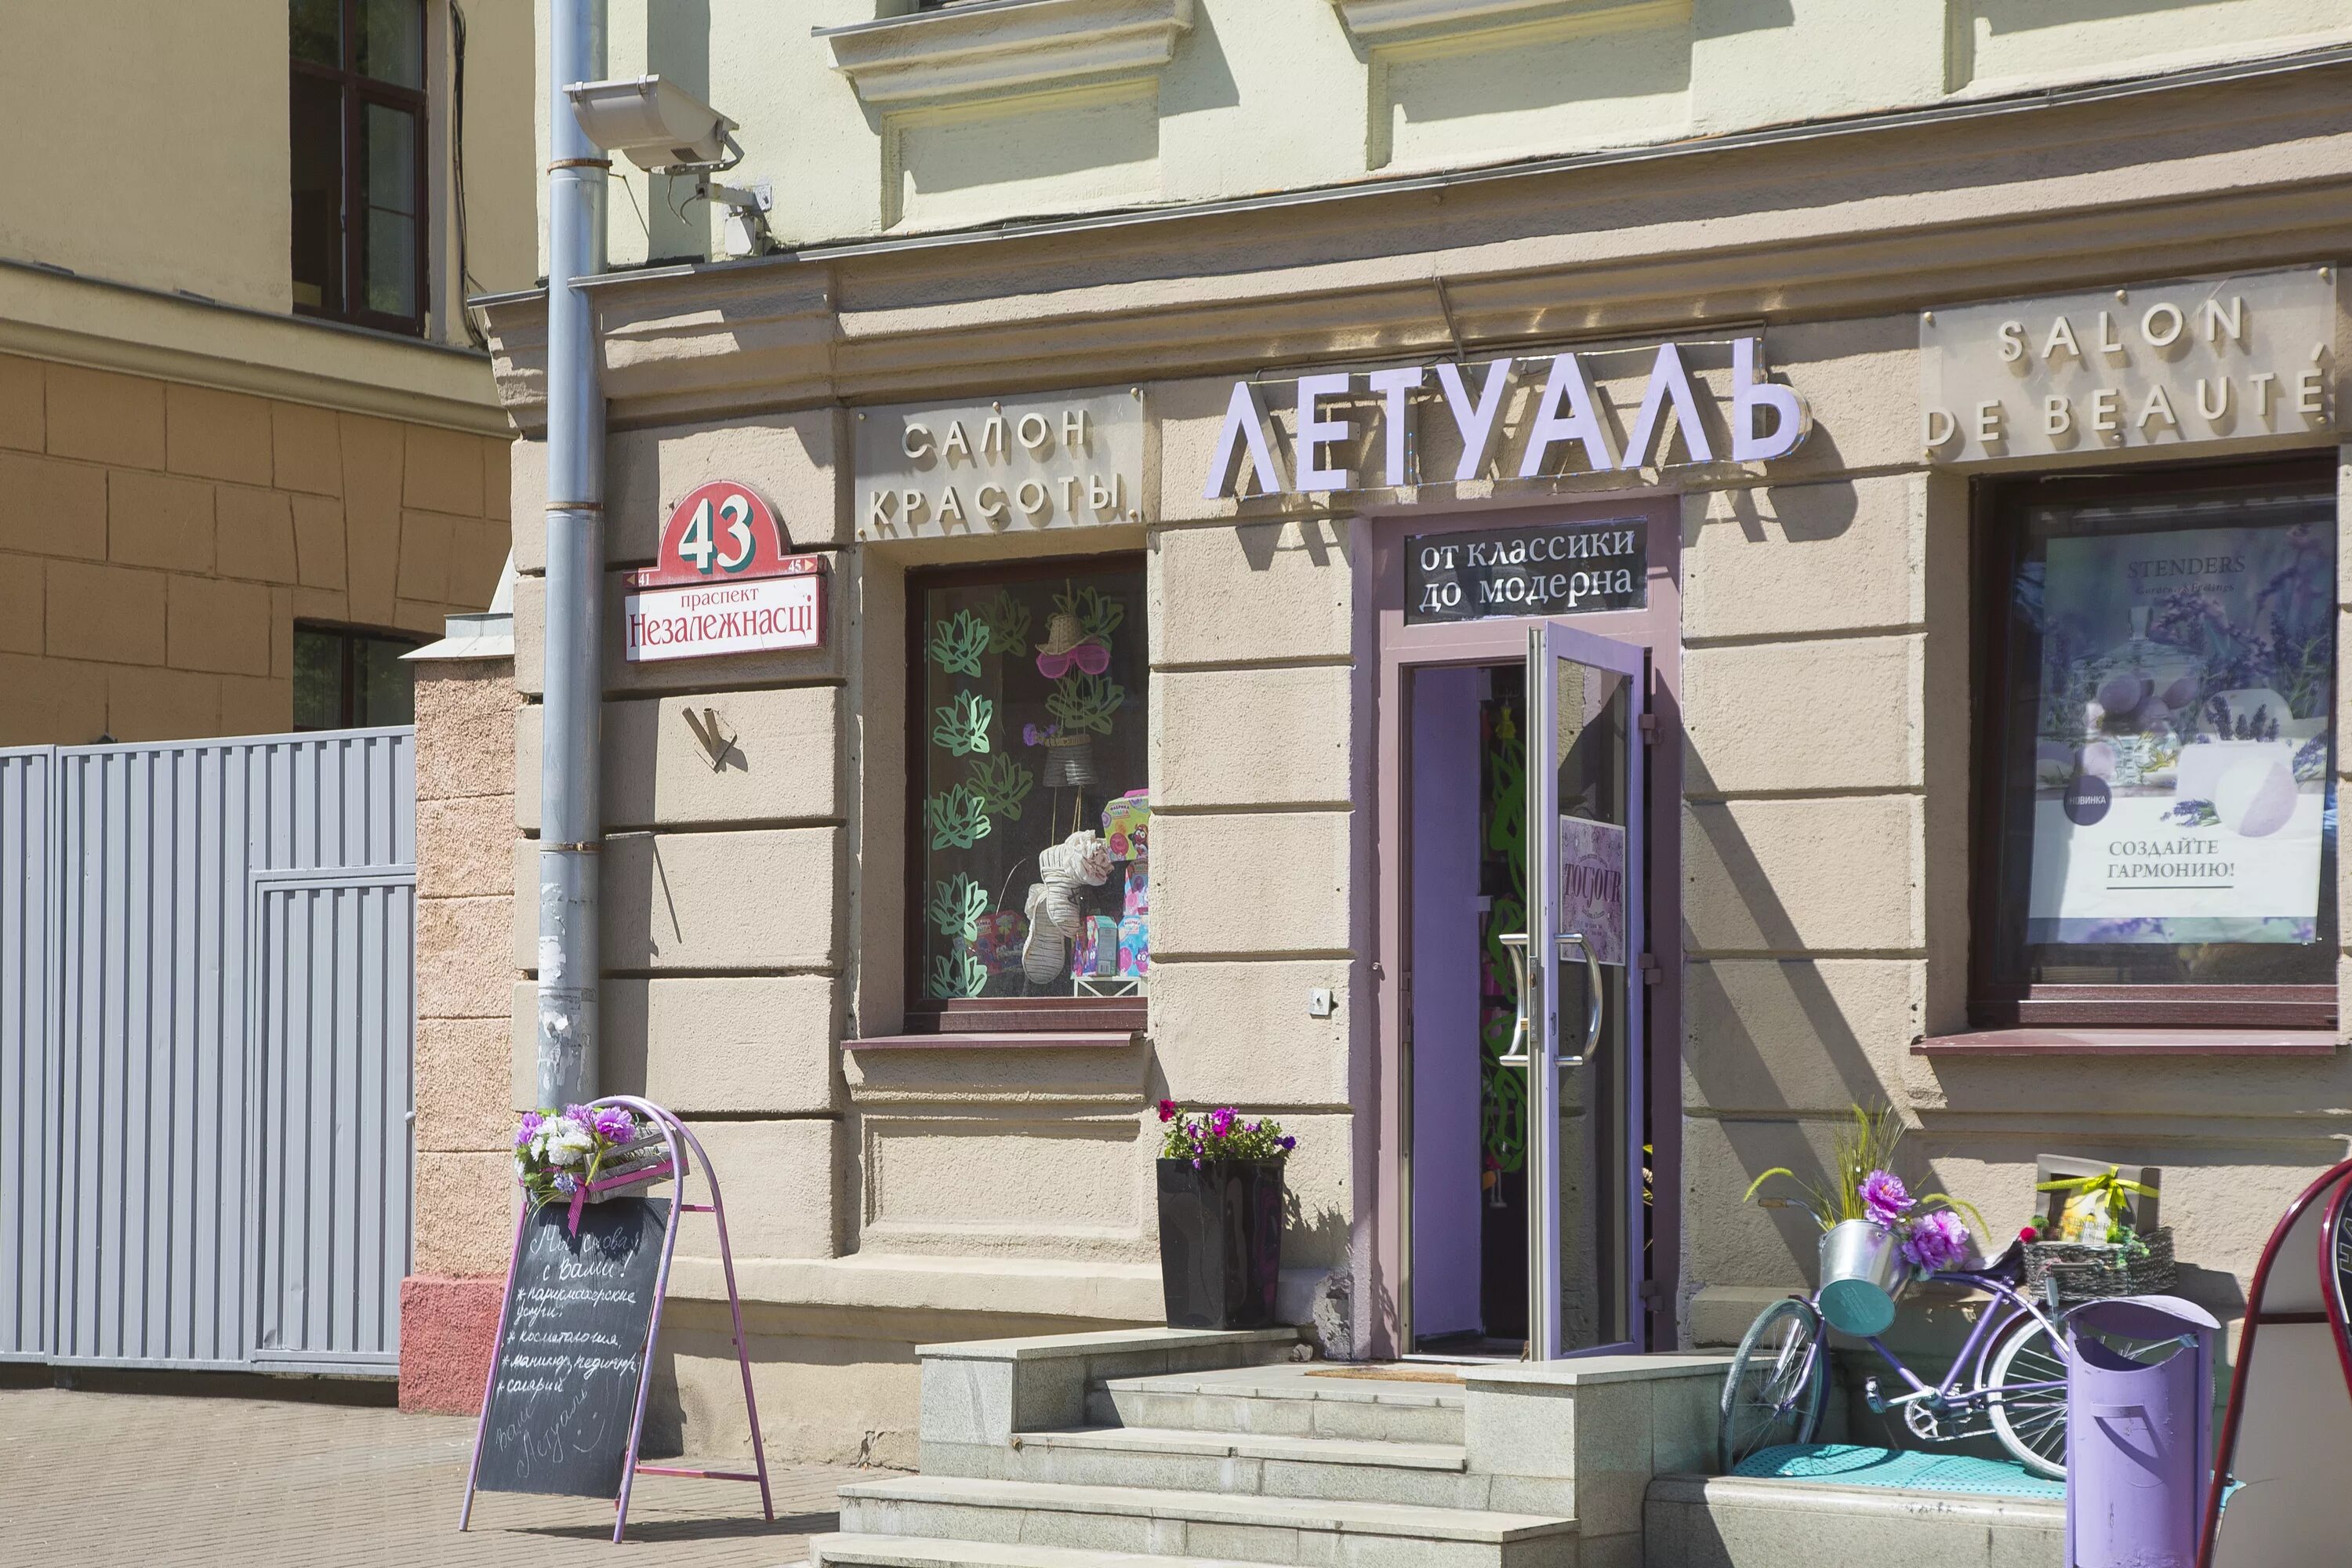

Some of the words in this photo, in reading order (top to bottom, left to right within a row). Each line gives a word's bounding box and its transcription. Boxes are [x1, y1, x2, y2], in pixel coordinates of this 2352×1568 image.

[1998, 296, 2241, 362] SALON
[1925, 399, 2002, 447] DE
[2044, 343, 2326, 436] BEAUTÉ
[902, 409, 1085, 459] САЛОН
[1203, 337, 1805, 498] ЛЕТУАЛЬ
[869, 473, 1120, 525] КРАСОТЫ
[678, 494, 754, 572] 43
[1421, 545, 1459, 571] от
[1467, 531, 1635, 568] классики
[638, 573, 650, 586] 41
[788, 559, 801, 572] 45
[2127, 555, 2246, 579] STENDERS
[681, 587, 760, 611] праспект
[1419, 582, 1461, 614] до
[1479, 568, 1633, 608] модерна
[630, 594, 813, 648] Незалежнасці
[2069, 795, 2107, 805] НОВИНКА
[2109, 837, 2220, 858] СОЗДАЙТЕ
[2107, 862, 2235, 880] ГАРМОНИЮ!
